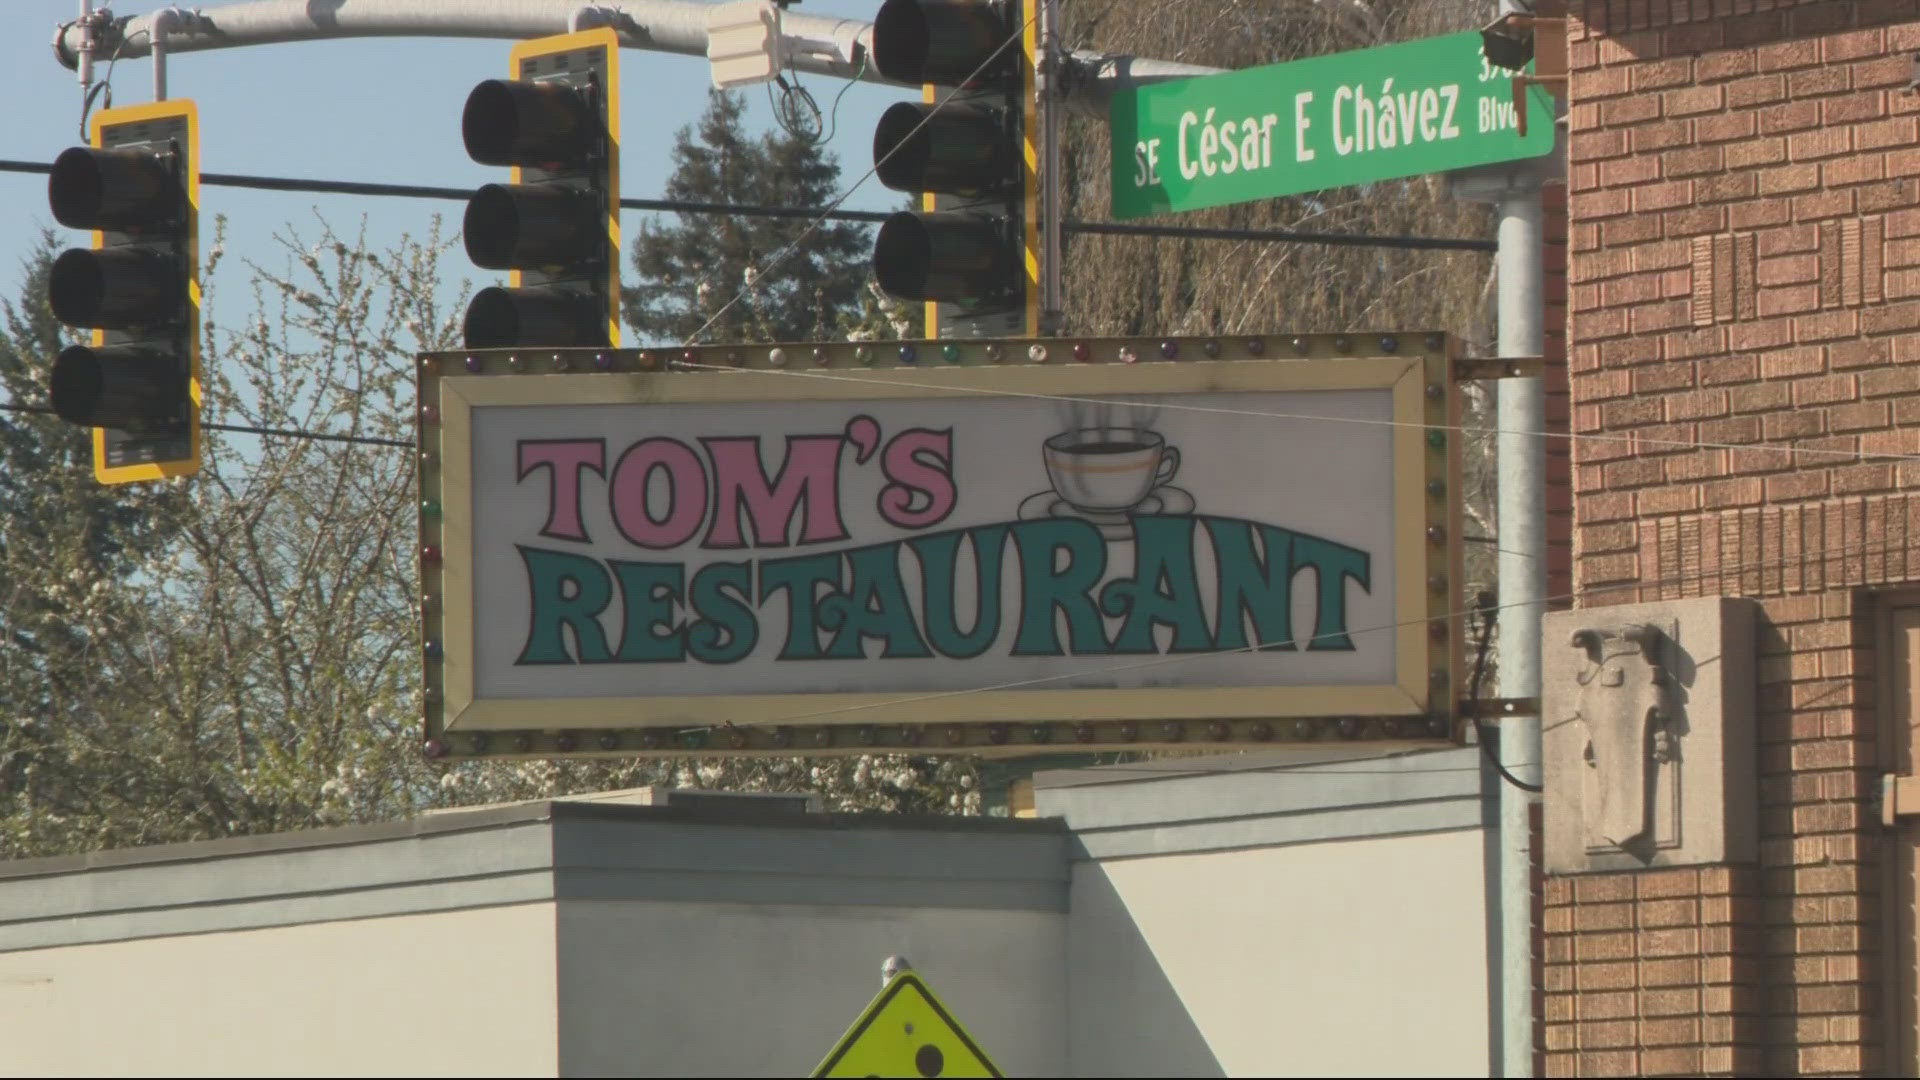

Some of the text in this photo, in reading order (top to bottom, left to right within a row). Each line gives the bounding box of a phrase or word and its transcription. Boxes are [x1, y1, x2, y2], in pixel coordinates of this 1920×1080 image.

[1134, 138, 1161, 187] SE
[1178, 107, 1278, 180] César
[1295, 91, 1316, 163] E
[1332, 77, 1460, 157] Chávez
[516, 413, 958, 550] TOM'S
[513, 514, 1372, 666] RESTAURANT
